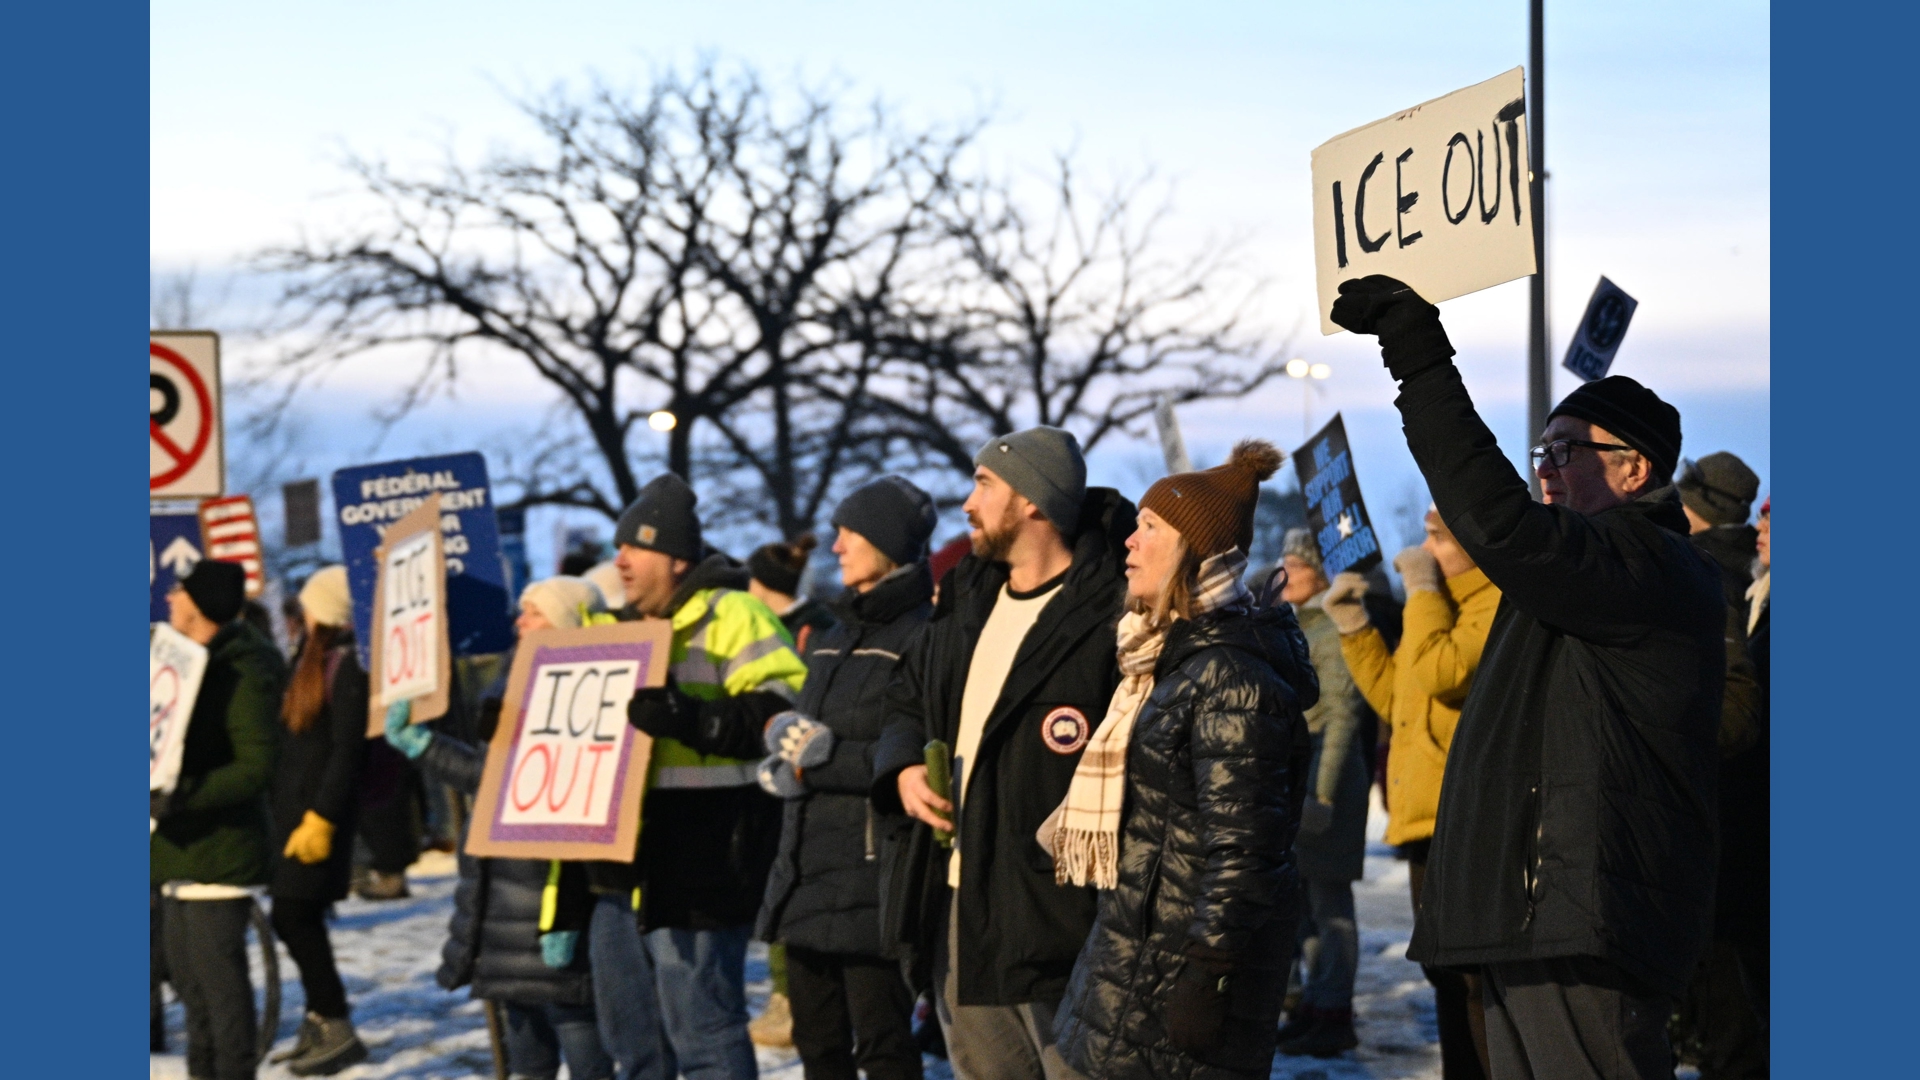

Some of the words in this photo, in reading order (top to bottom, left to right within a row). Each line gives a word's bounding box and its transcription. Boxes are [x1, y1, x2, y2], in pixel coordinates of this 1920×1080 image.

[1332, 147, 1423, 273] ICE
[1442, 98, 1526, 226] OUT
[361, 469, 461, 499] FEDERAL
[390, 545, 429, 616] ICE
[387, 612, 432, 685] OUT
[530, 667, 629, 741] ICE
[511, 743, 614, 817] OUT
